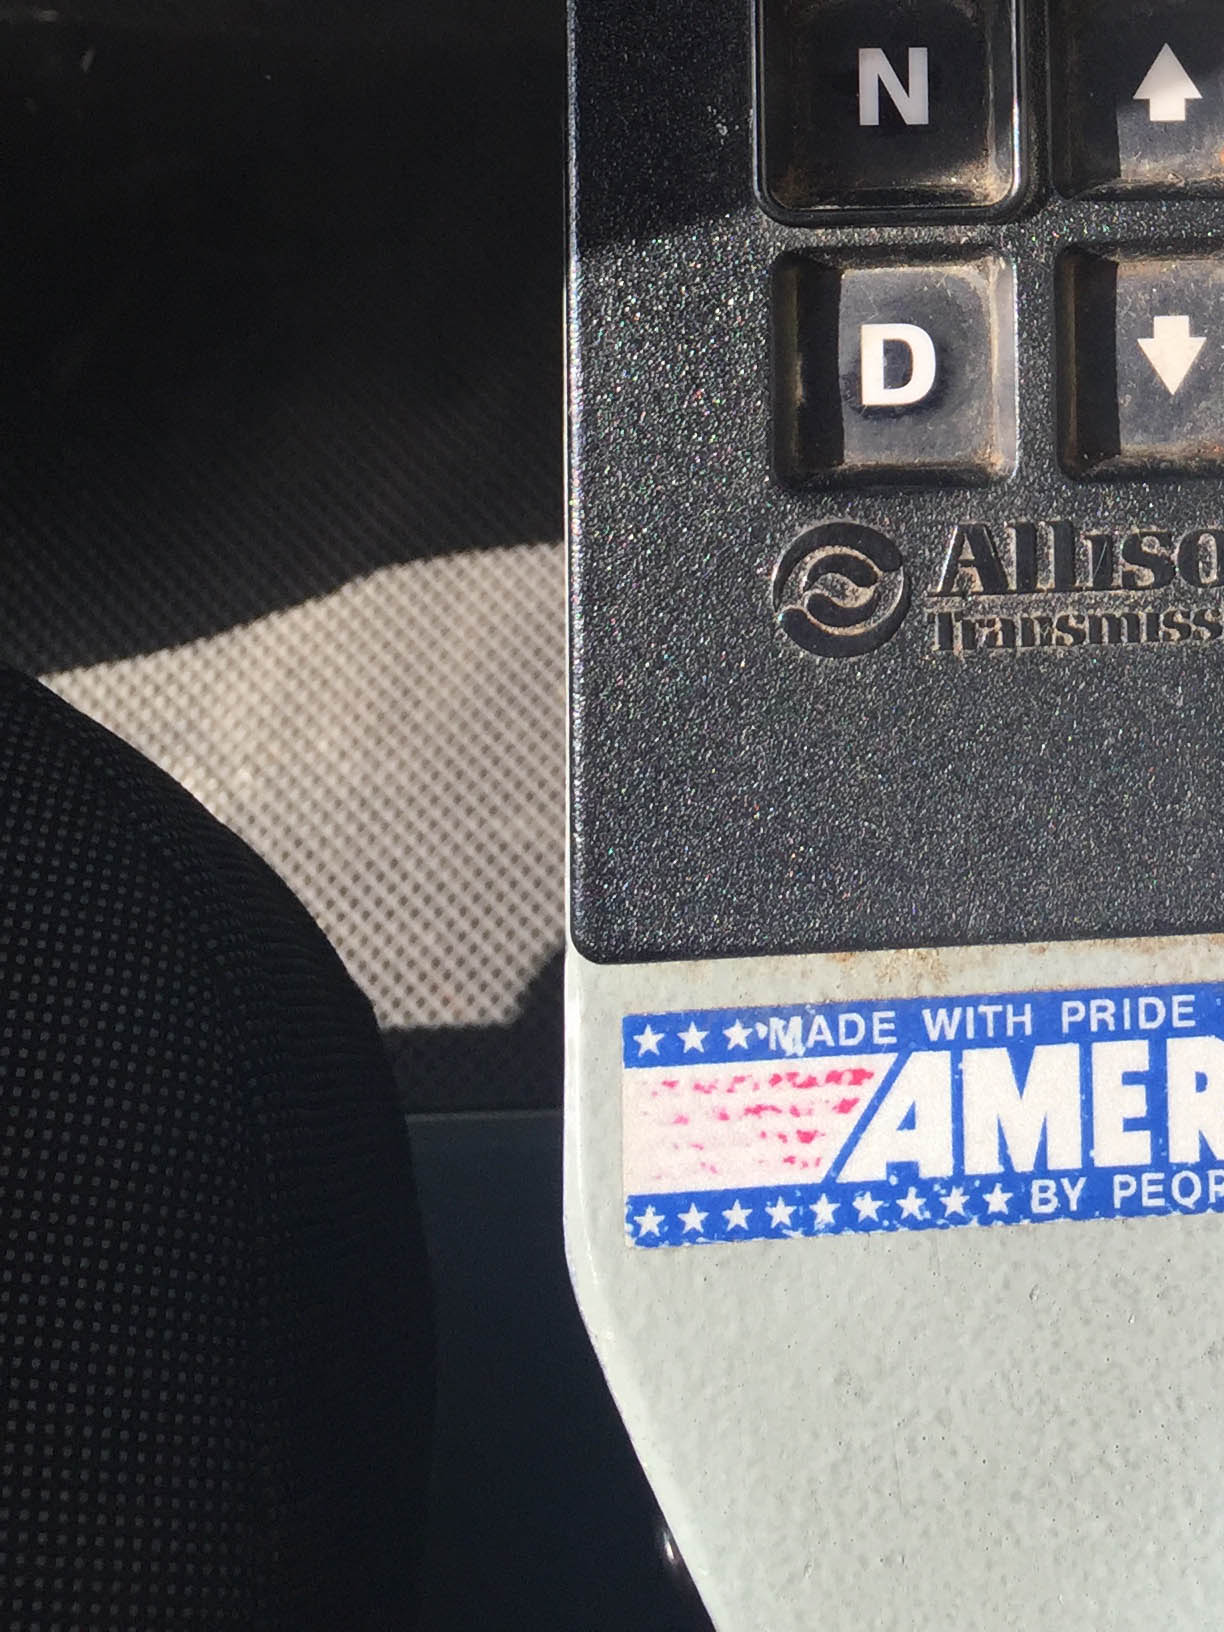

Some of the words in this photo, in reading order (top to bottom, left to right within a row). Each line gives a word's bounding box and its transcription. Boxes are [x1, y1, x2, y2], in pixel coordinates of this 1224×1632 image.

[857, 47, 929, 126] N
[860, 323, 936, 406] D
[768, 1011, 897, 1052] MADE
[922, 1004, 1033, 1042] WITH
[1061, 994, 1196, 1033] PRIDE
[1030, 1177, 1086, 1214] BY
